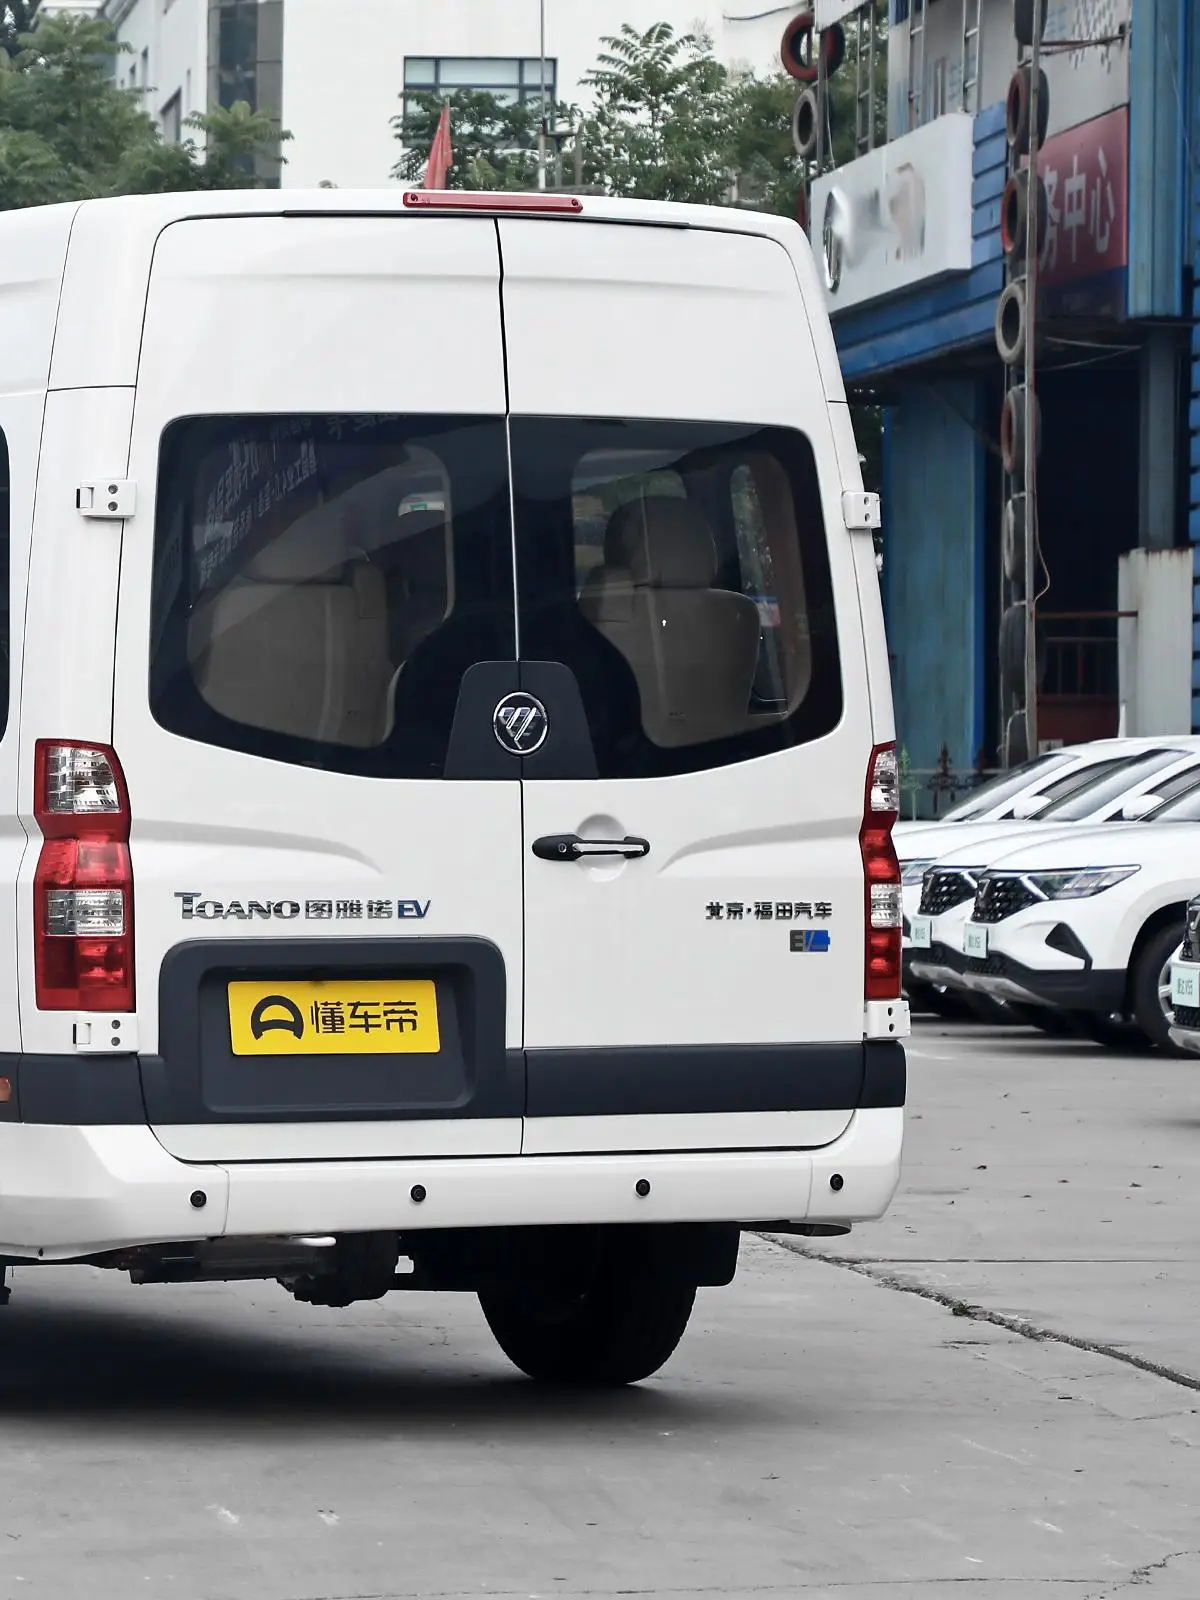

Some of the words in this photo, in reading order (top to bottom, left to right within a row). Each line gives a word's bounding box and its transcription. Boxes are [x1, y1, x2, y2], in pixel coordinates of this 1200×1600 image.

[305, 899, 393, 920] 图雅诺
[397, 899, 432, 919] EV
[310, 1000, 418, 1033] 懂车帝
